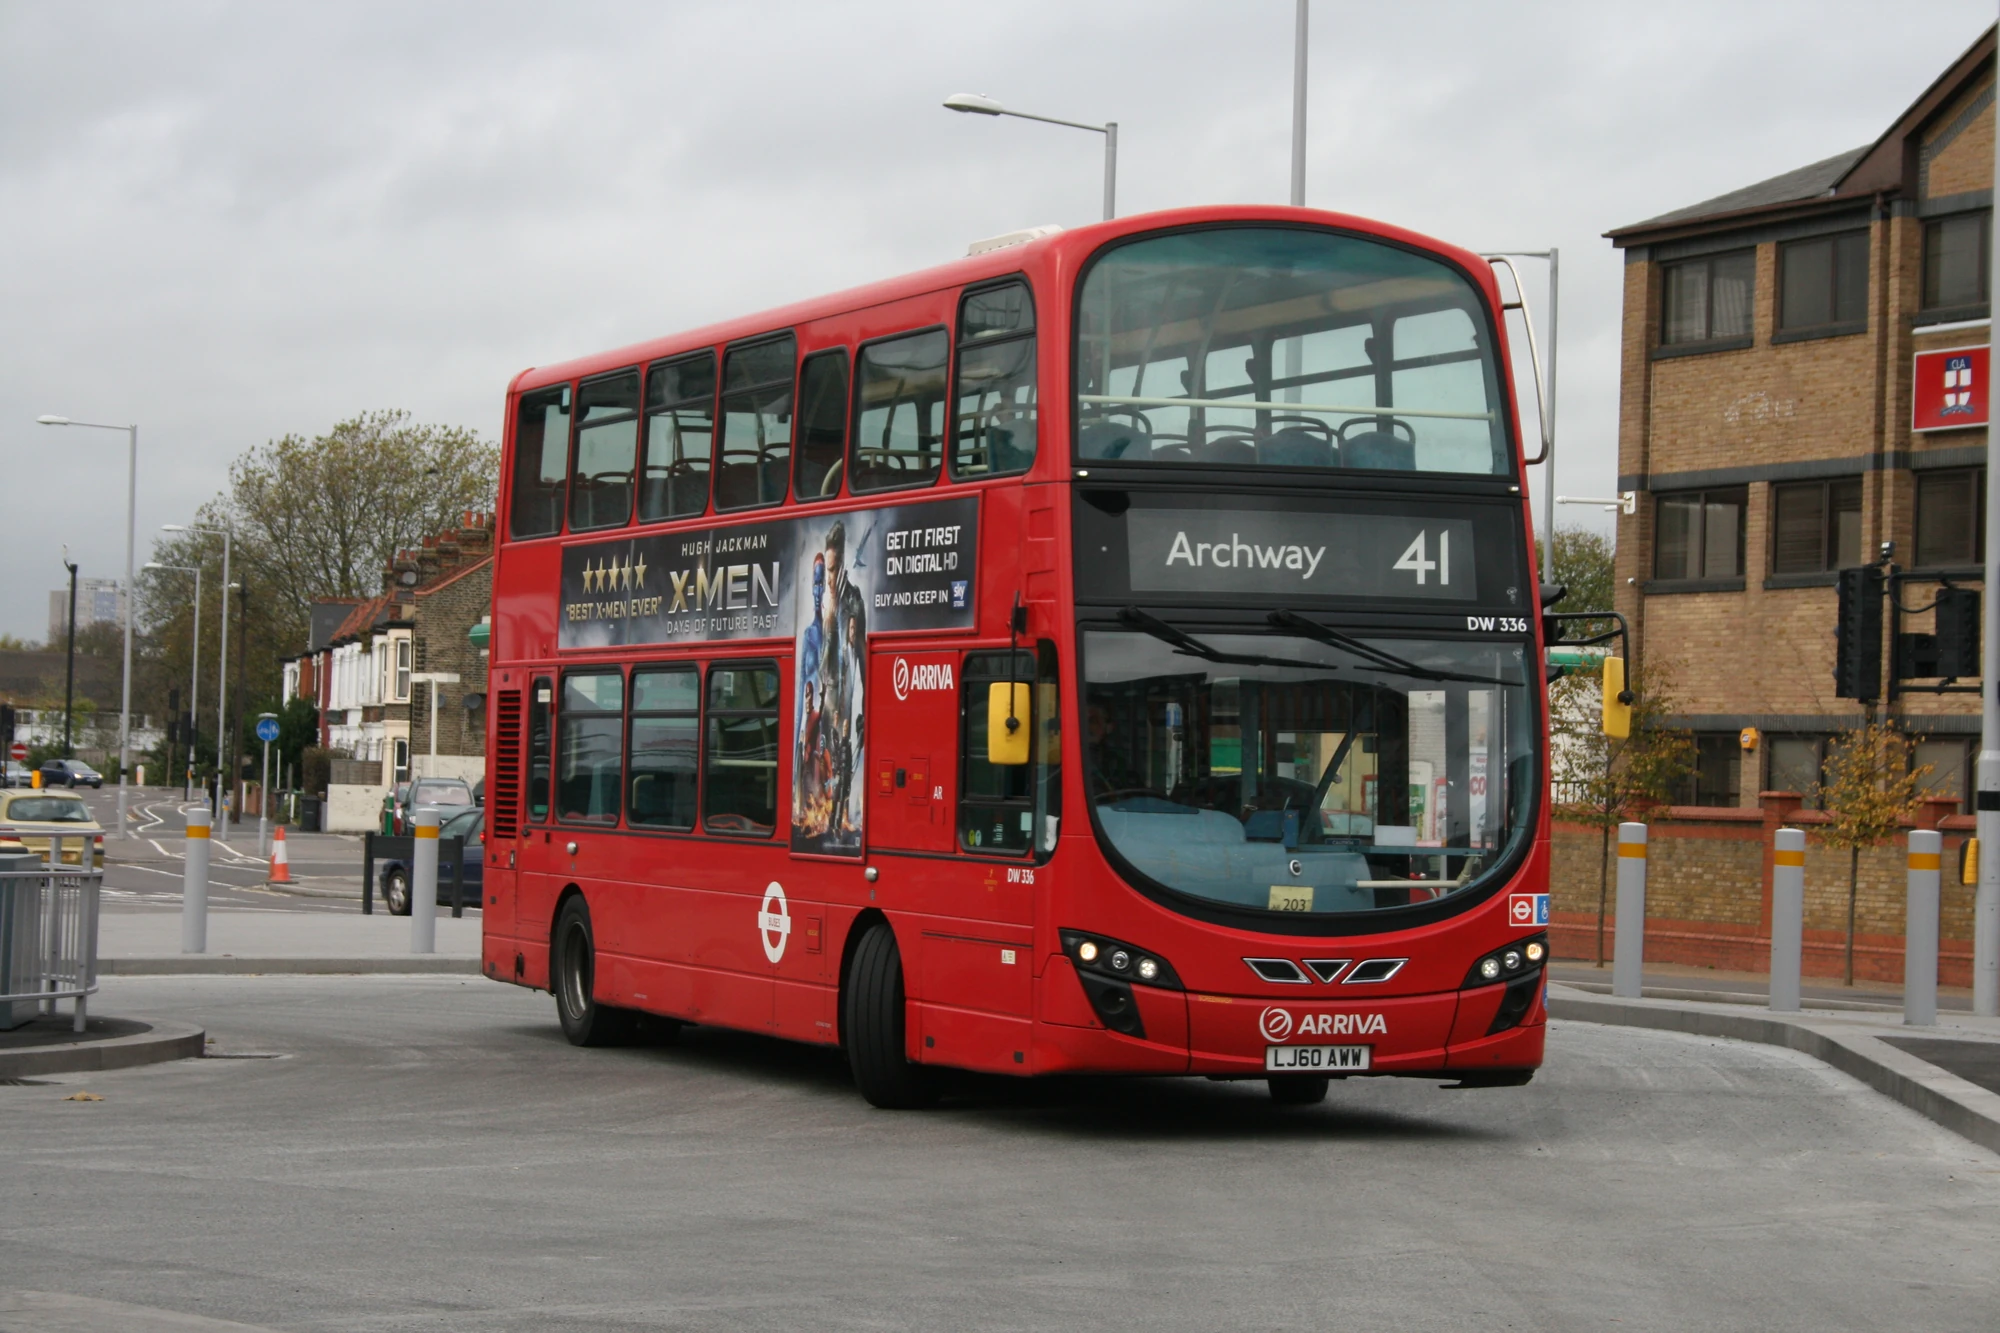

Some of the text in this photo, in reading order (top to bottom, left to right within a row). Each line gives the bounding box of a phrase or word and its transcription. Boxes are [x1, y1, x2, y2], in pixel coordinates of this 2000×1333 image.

[1951, 359, 1966, 370] CLA
[681, 535, 767, 557] HUGH JACKMAN
[886, 525, 961, 550] GET IT FIRST
[886, 552, 958, 575] ON DIGITAL HD
[1165, 529, 1449, 585] Archway 41
[668, 561, 780, 614] X-MEN
[953, 583, 965, 600] sky
[875, 590, 948, 607] BUY AND KEEP IN
[667, 614, 778, 635] DAYS OF FUTURE PAST
[1467, 617, 1527, 632] DW 336
[911, 664, 953, 690] ARRIVA
[933, 786, 943, 800] AR
[1007, 868, 1034, 884] DW 336
[1283, 898, 1306, 911] 203
[1297, 1014, 1388, 1035] ARRIVA
[1274, 1048, 1362, 1067] LJ60 AWW
